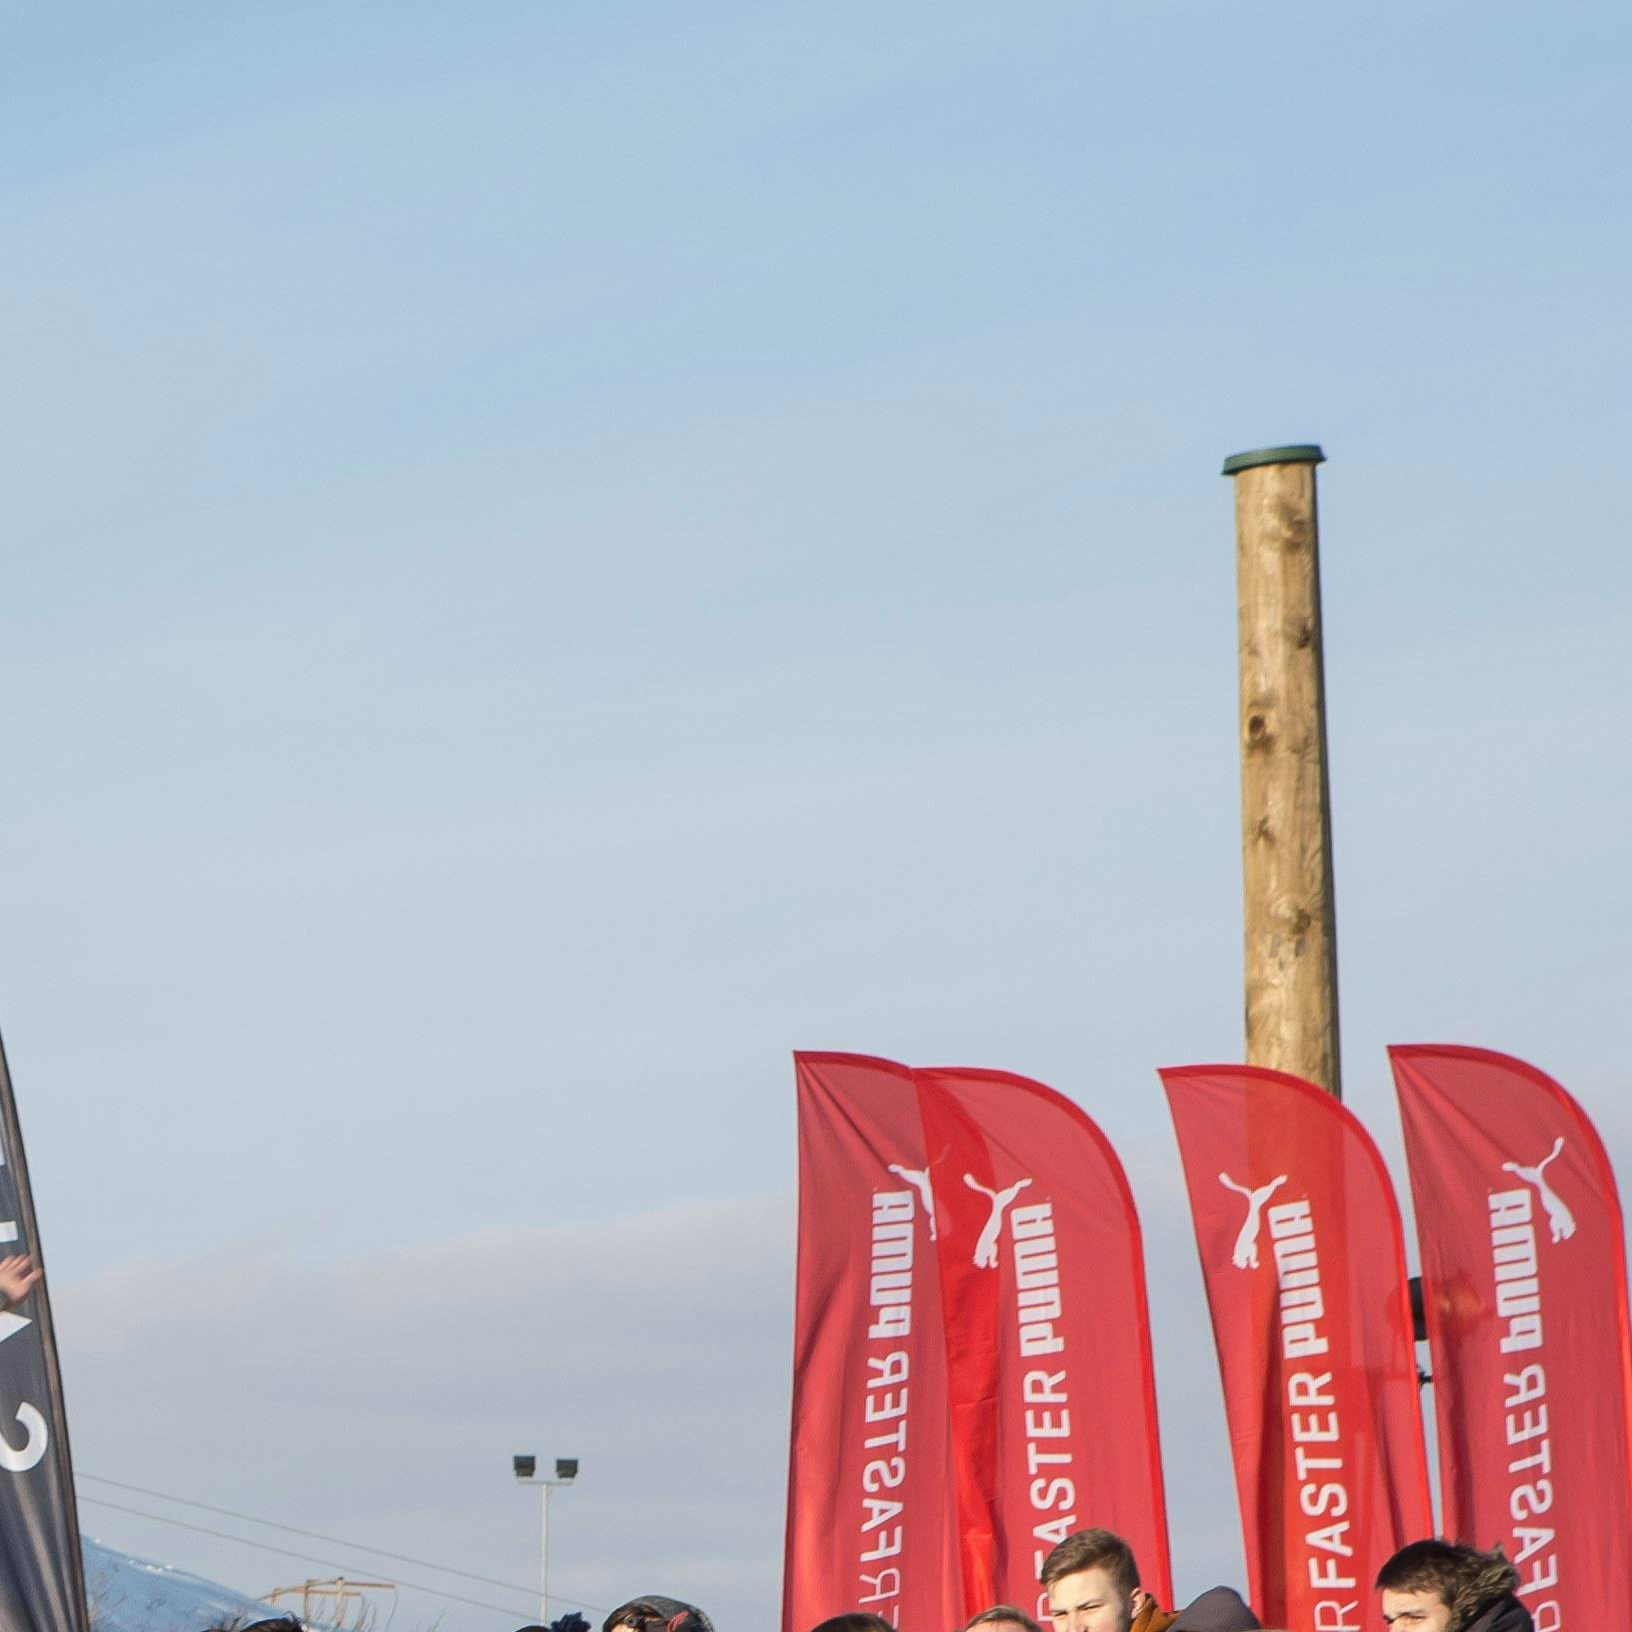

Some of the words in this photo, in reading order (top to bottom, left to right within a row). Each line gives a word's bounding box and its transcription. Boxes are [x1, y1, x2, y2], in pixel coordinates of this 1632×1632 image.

[1010, 1202, 1066, 1358] PUMA
[1267, 1199, 1329, 1359] PUMA
[1288, 1370, 1359, 1590] FASTER
